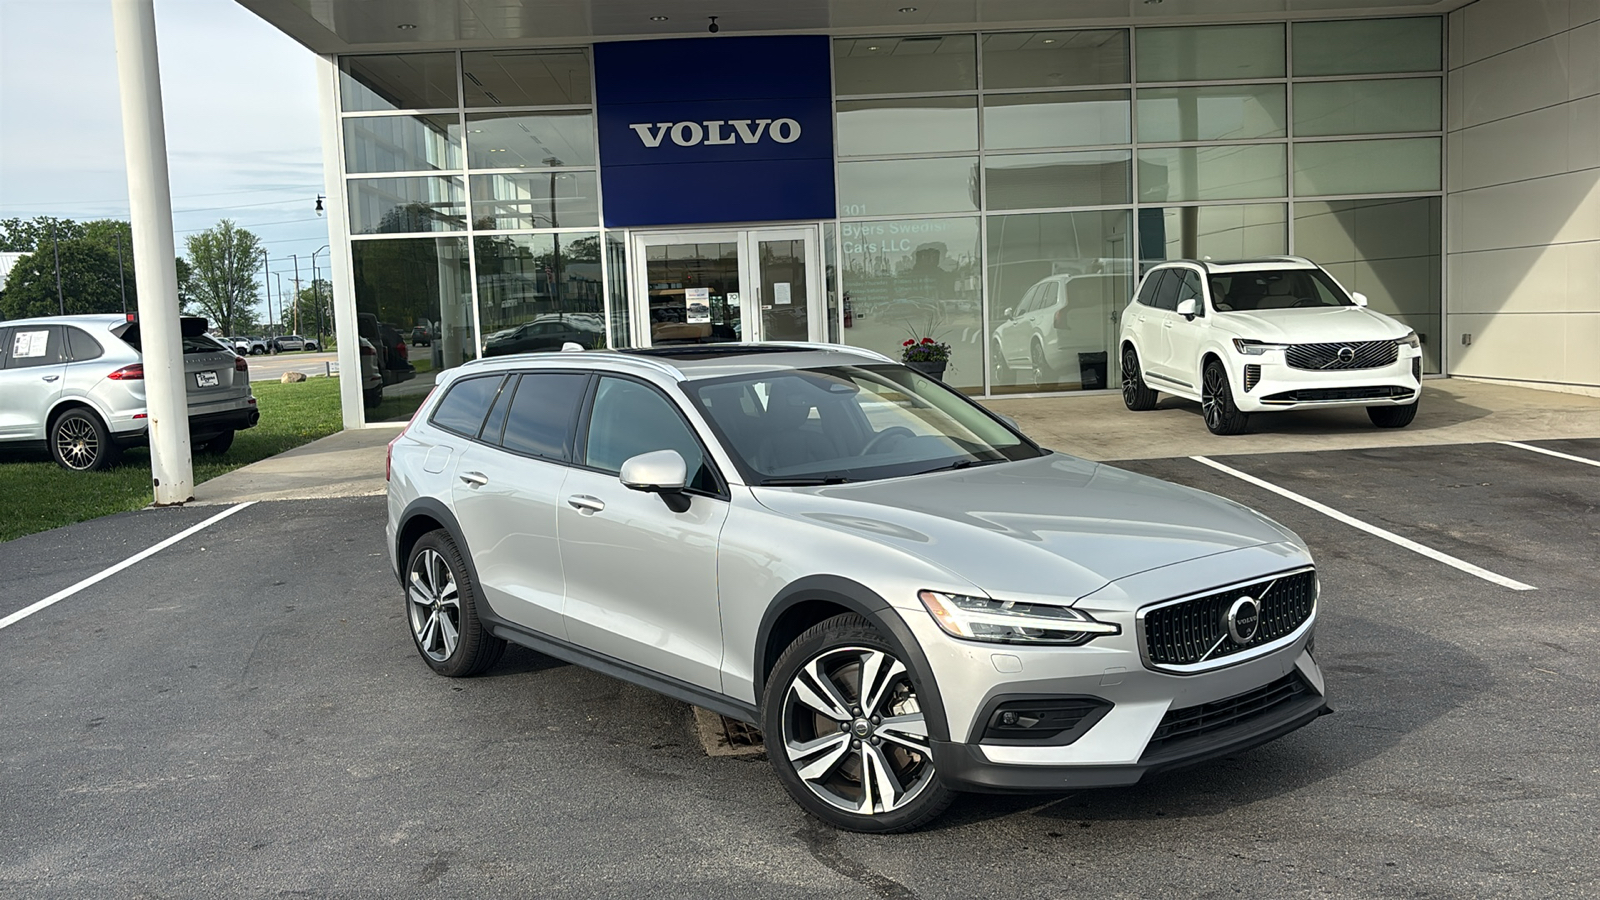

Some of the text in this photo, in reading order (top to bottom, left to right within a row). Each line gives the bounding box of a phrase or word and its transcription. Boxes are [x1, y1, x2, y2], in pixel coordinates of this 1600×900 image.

[629, 118, 801, 148] VOLVO
[843, 204, 866, 216] 301
[843, 225, 884, 239] Byers
[843, 238, 911, 254] Cars LLC
